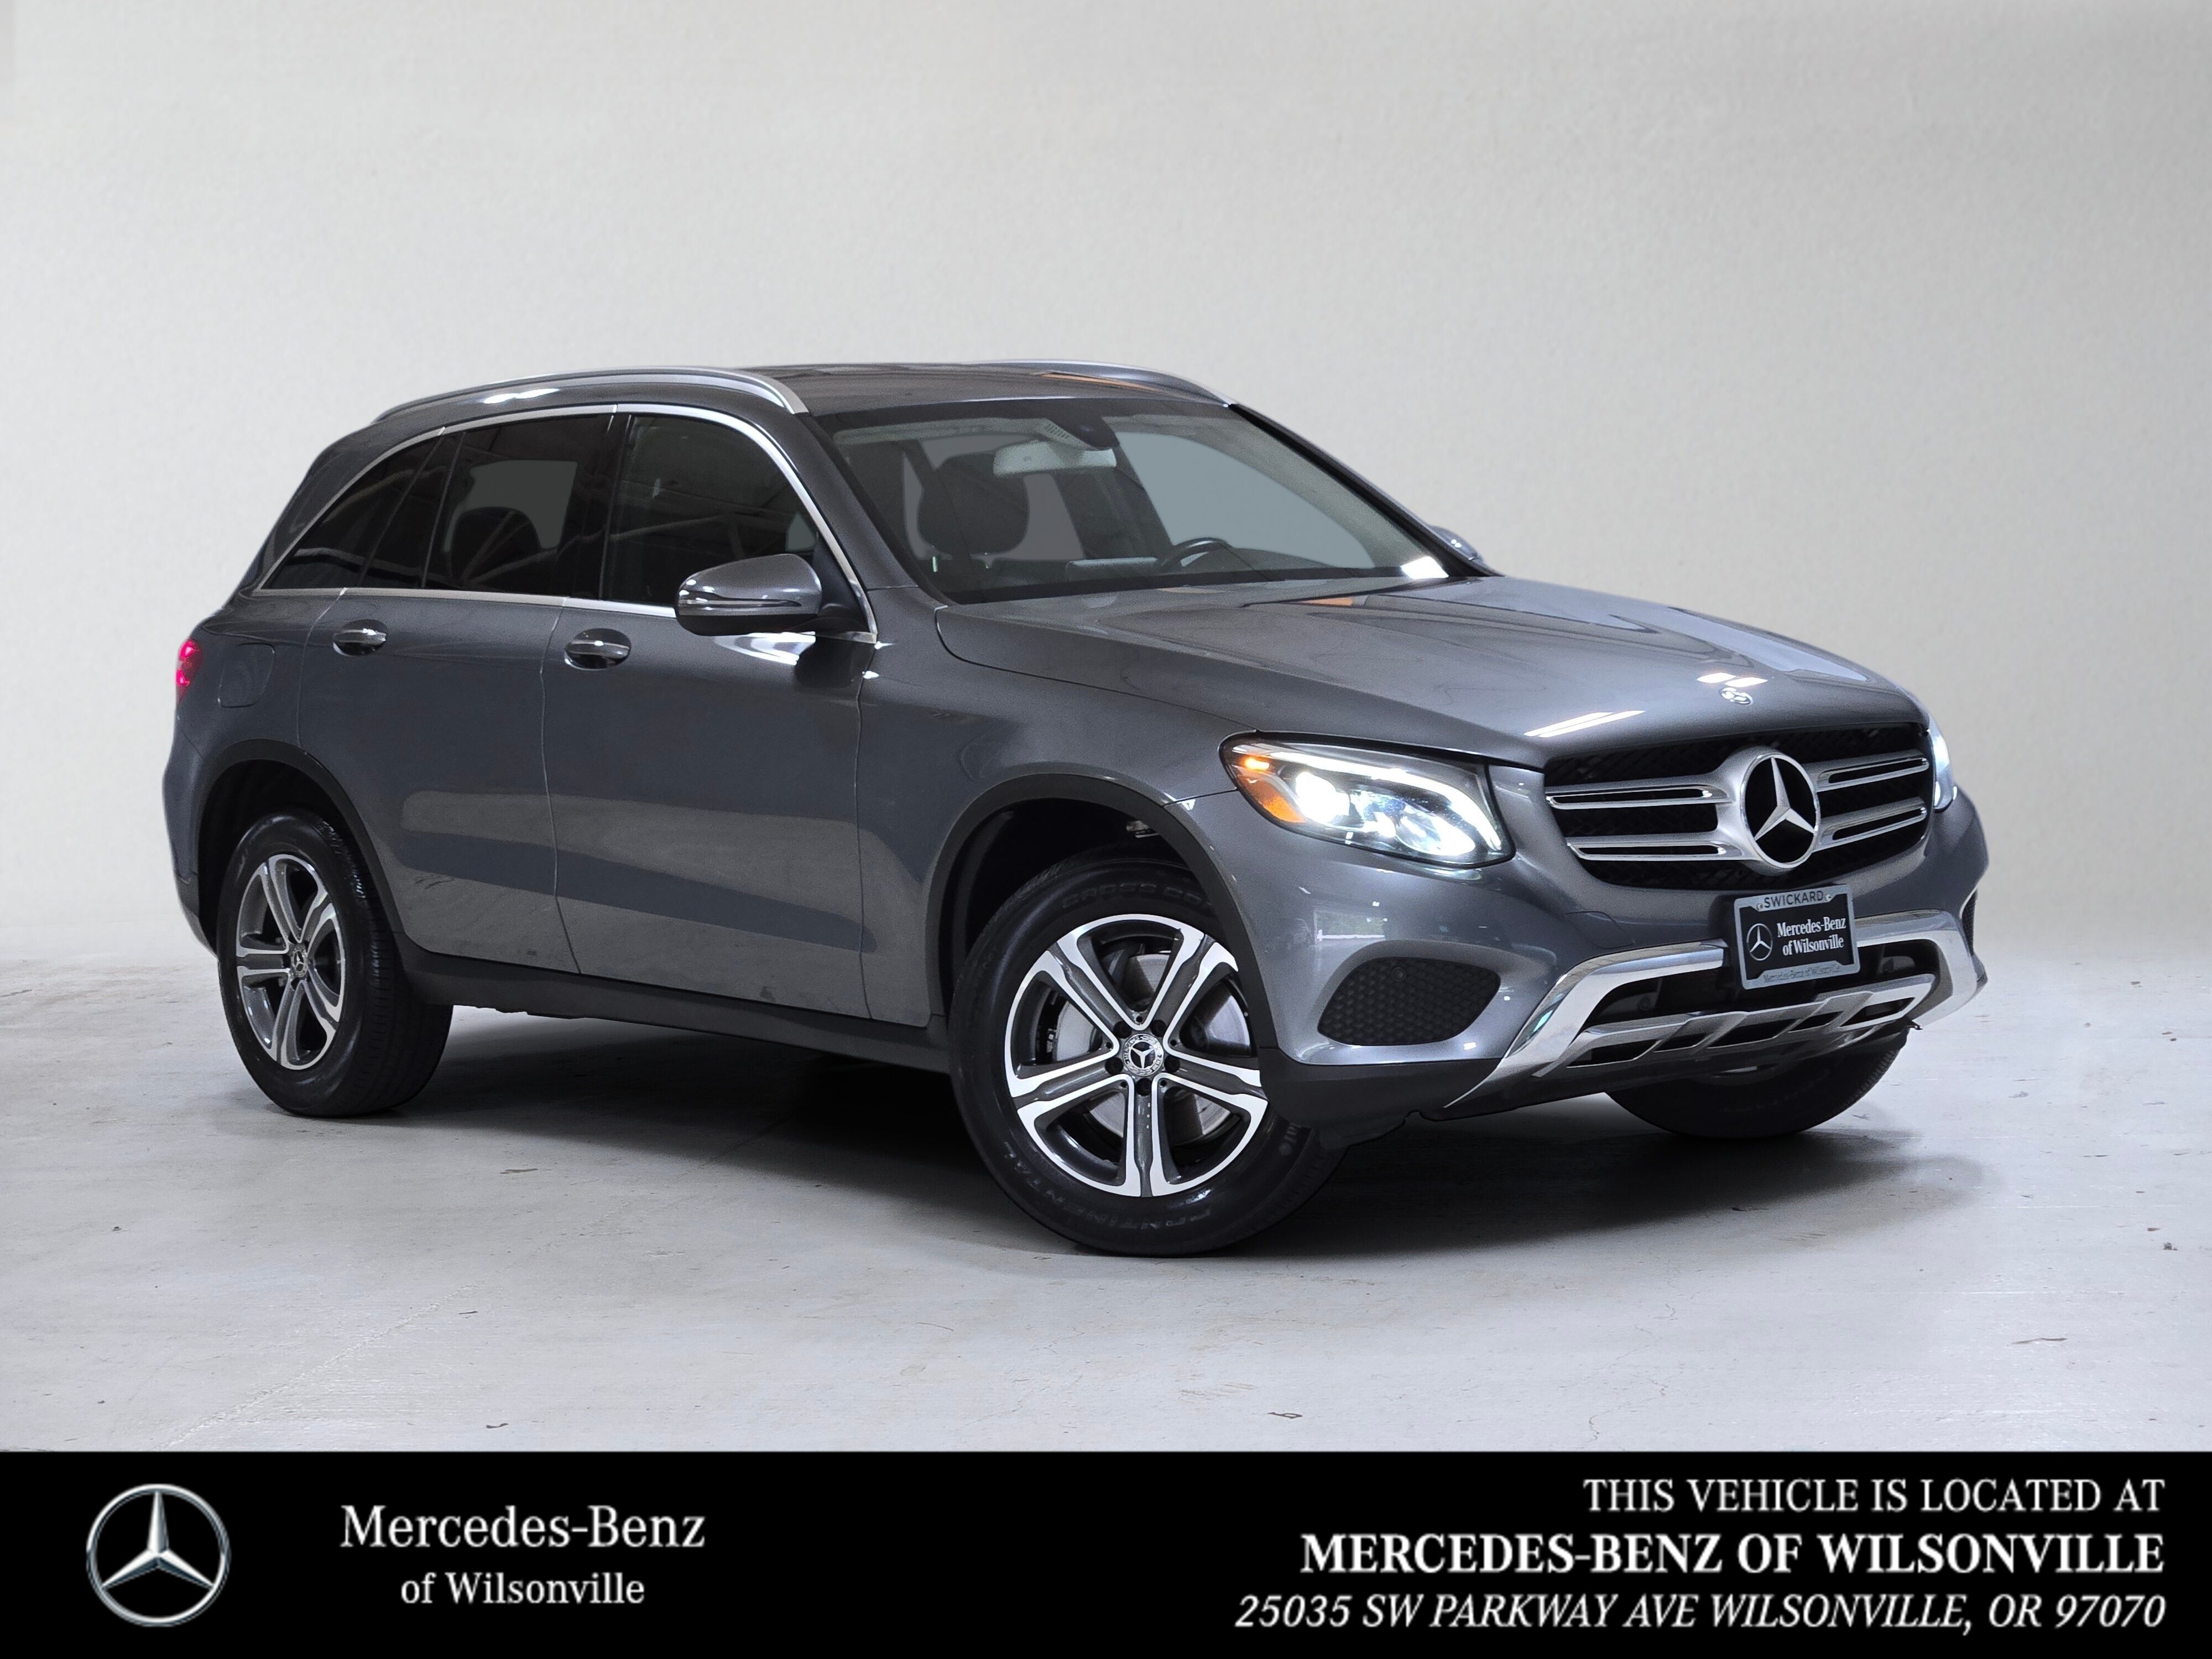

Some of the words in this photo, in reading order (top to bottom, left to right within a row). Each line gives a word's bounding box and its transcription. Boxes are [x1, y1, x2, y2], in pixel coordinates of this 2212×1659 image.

[1764, 890, 1824, 908] SWICKARD
[1776, 916, 1846, 937] Mercedes-Benz
[1782, 941, 1793, 956] of
[1793, 934, 1844, 953] Wilsonville
